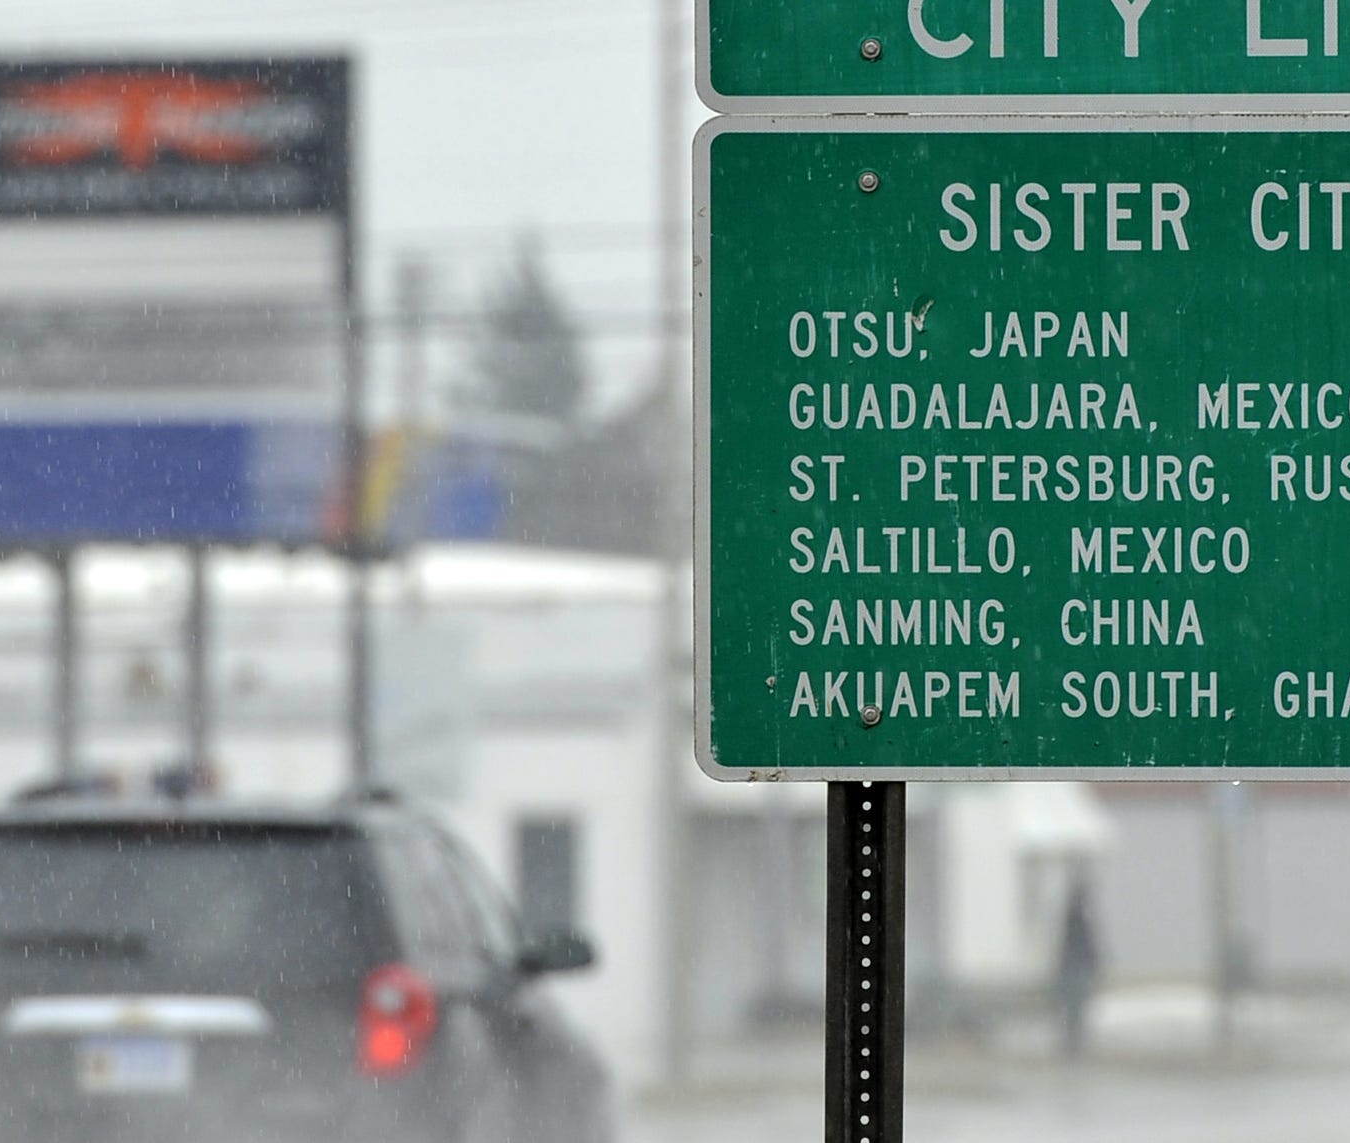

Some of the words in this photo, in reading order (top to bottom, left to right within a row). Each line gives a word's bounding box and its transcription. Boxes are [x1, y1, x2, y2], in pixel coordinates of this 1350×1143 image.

[940, 182, 1190, 252] SISTER
[789, 311, 928, 361] OTSU,
[970, 311, 1128, 358] JAPAN
[789, 383, 1157, 433] GUADALAJARA,
[789, 455, 860, 502] ST.
[901, 454, 1230, 505] PETERSBURG,
[789, 527, 1031, 577] SALTILLO,
[1071, 527, 1250, 574] MEXICO
[789, 599, 1020, 649] SANMING,
[1061, 599, 1204, 646] CHINA
[789, 671, 1020, 718] AKUAPEM
[1061, 671, 1234, 722] SOUTH,
